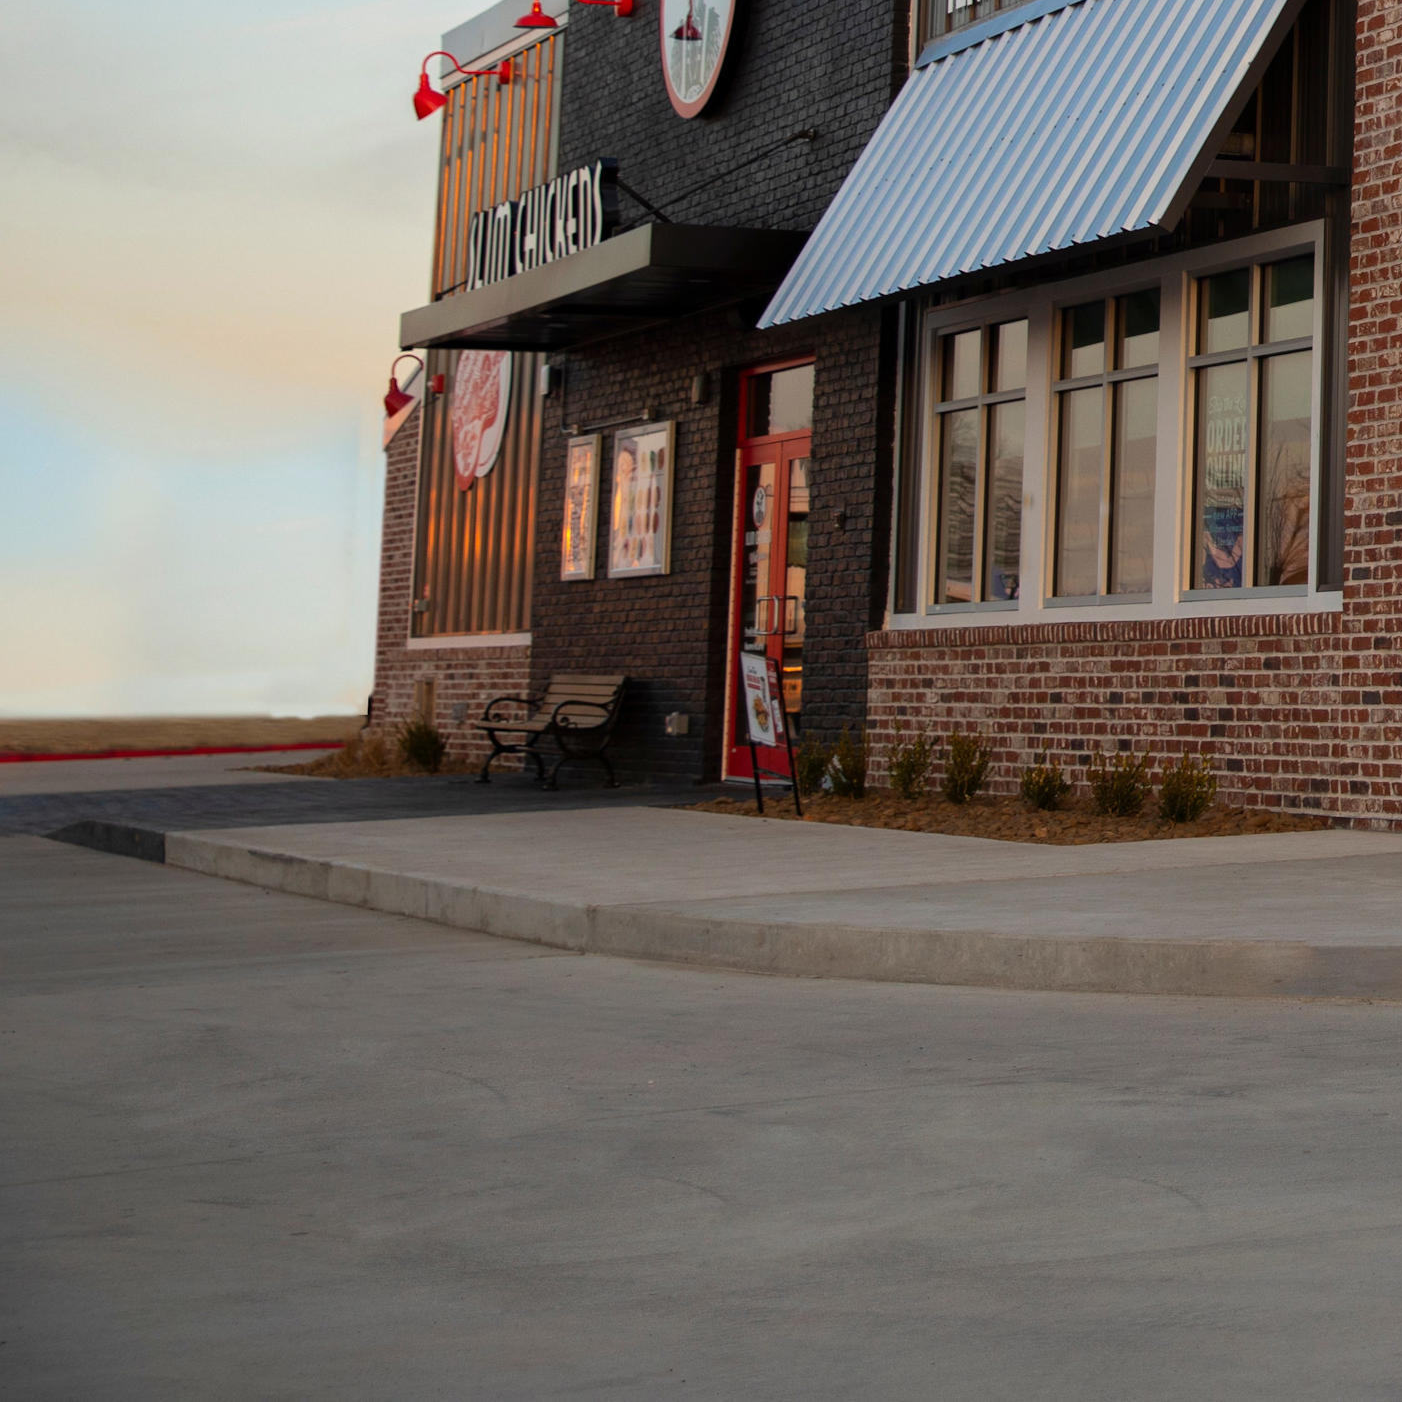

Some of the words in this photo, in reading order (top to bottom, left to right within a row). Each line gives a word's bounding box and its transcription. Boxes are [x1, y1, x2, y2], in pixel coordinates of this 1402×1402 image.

[466, 200, 512, 293] SLIM
[515, 159, 603, 275] CHICKENS
[1205, 453, 1246, 490] ONLIN
